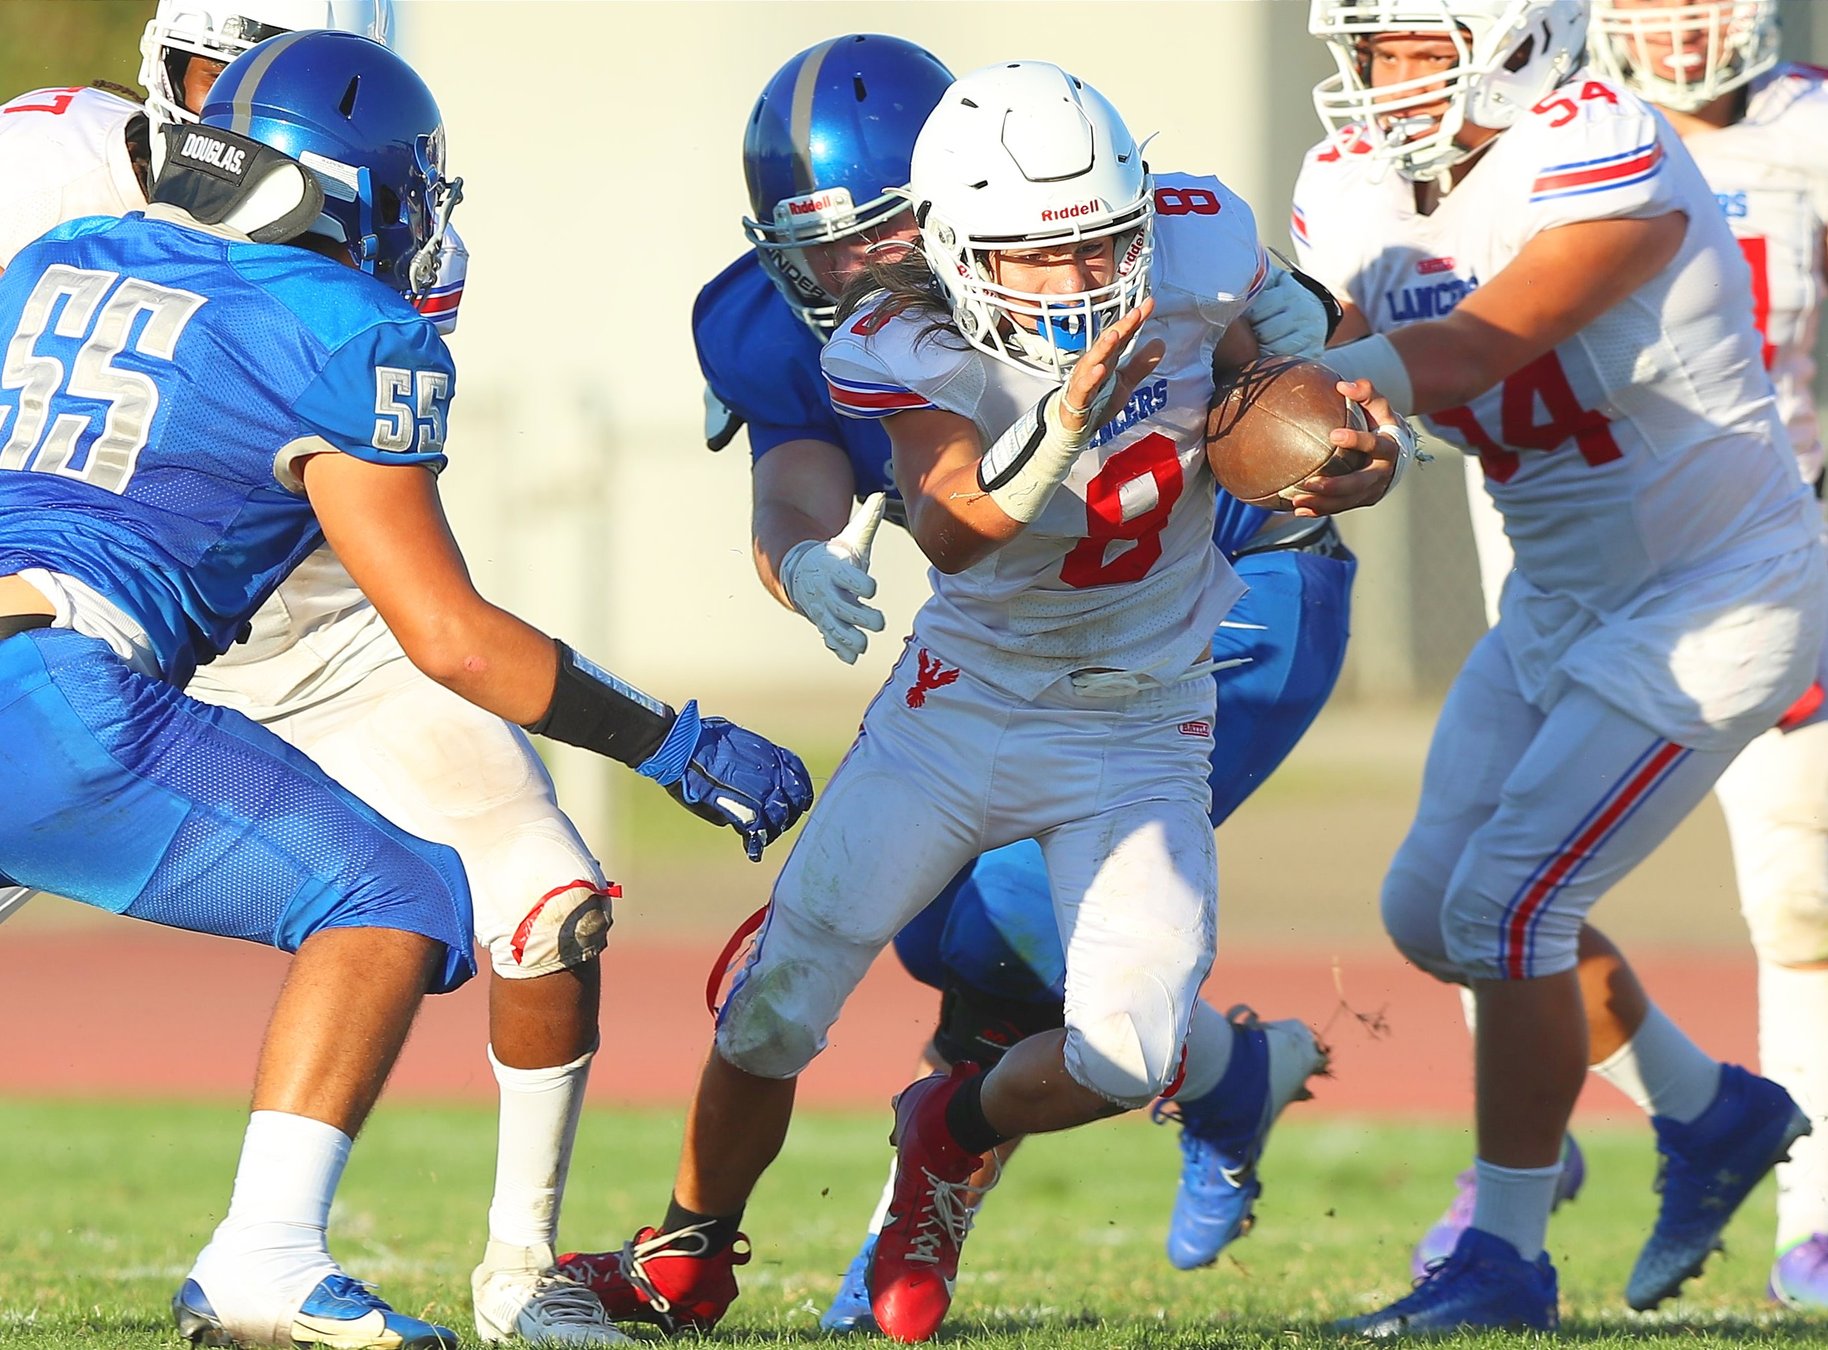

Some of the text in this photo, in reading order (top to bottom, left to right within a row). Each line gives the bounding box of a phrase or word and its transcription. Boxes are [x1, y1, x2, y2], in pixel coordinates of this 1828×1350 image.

[1531, 81, 1619, 128] 54
[788, 194, 832, 216] Riddell
[1041, 199, 1100, 222] Riddell
[1154, 187, 1222, 216] 8
[769, 247, 827, 298] NDER
[0, 264, 208, 495] 55
[371, 366, 449, 454] 55
[1058, 431, 1184, 589] 8
